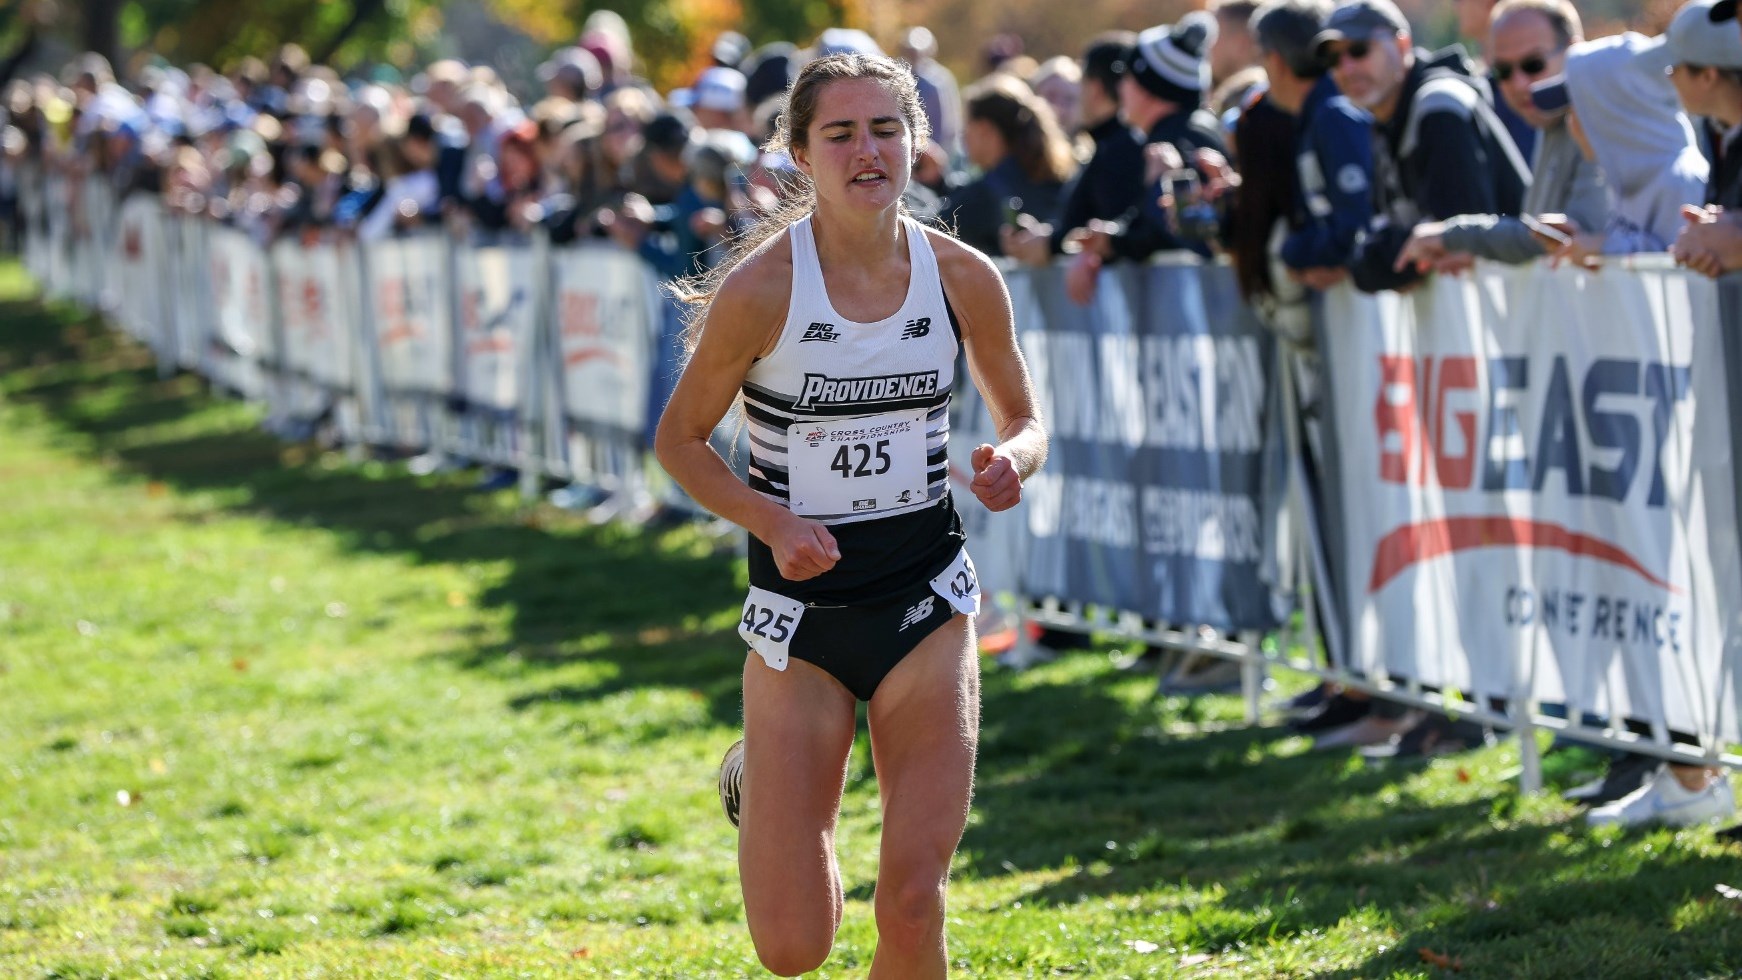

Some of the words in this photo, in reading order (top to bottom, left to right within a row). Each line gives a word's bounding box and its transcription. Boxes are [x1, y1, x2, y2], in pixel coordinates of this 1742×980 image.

[803, 331, 841, 341] EAST
[808, 322, 834, 332] BIG
[792, 370, 939, 411] PROVIDENCE
[830, 427, 911, 442] CHAMPIONSHIPS
[869, 421, 911, 433] COUNTRY
[830, 439, 891, 478] 425
[951, 558, 977, 600] 425
[743, 603, 794, 643] 425
